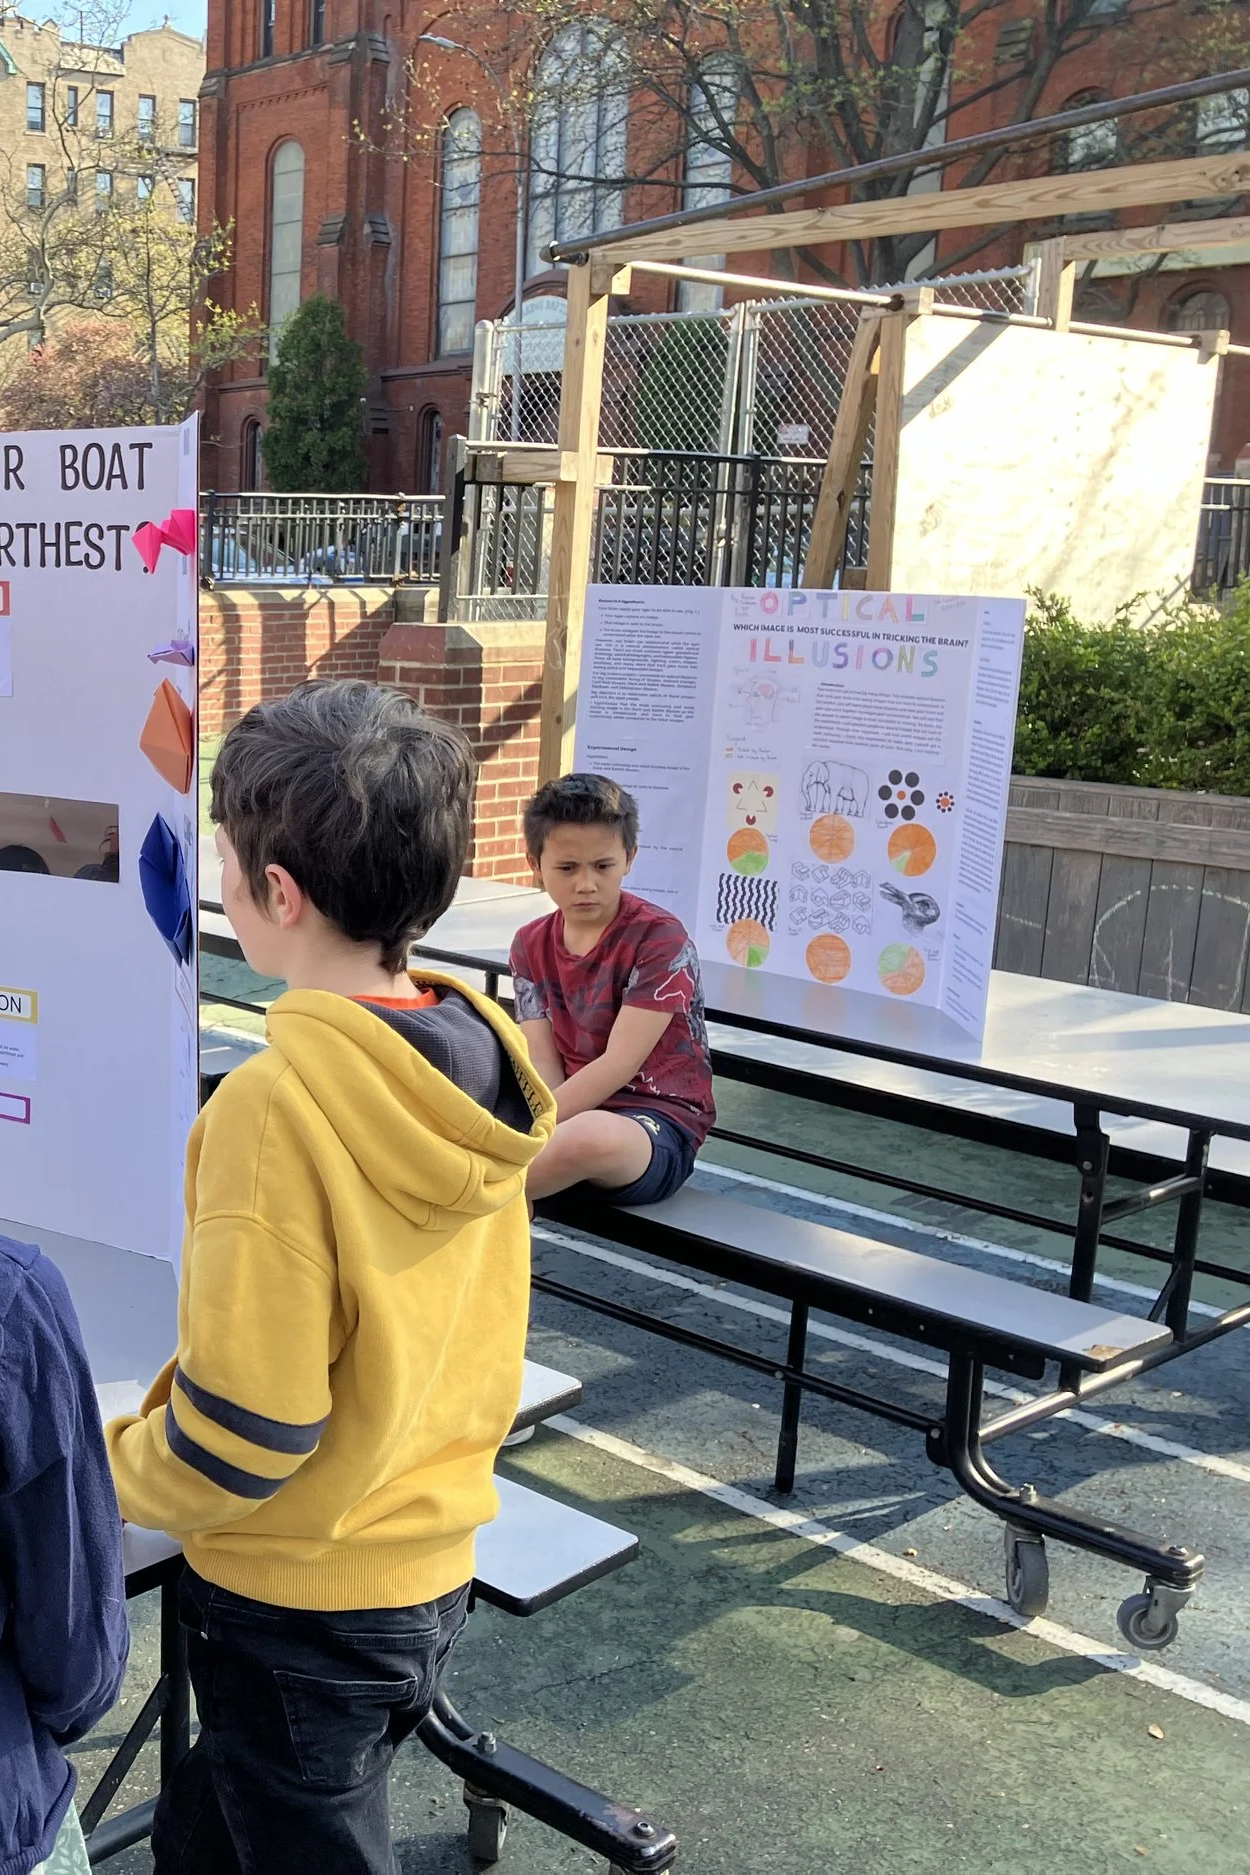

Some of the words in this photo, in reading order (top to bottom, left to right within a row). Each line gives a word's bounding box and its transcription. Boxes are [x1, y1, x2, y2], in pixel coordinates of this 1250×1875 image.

[59, 442, 153, 491] BOAT
[759, 591, 926, 623] OPTICAL
[733, 623, 760, 632] WHICH
[760, 624, 786, 633] IMAGE
[796, 626, 820, 635] MOST
[820, 628, 870, 640] SUCCESSFUL
[882, 633, 920, 644] TRICKING
[922, 636, 936, 645] THE
[938, 636, 969, 648] BRAIN?
[750, 637, 938, 677] ILLUSIONS
